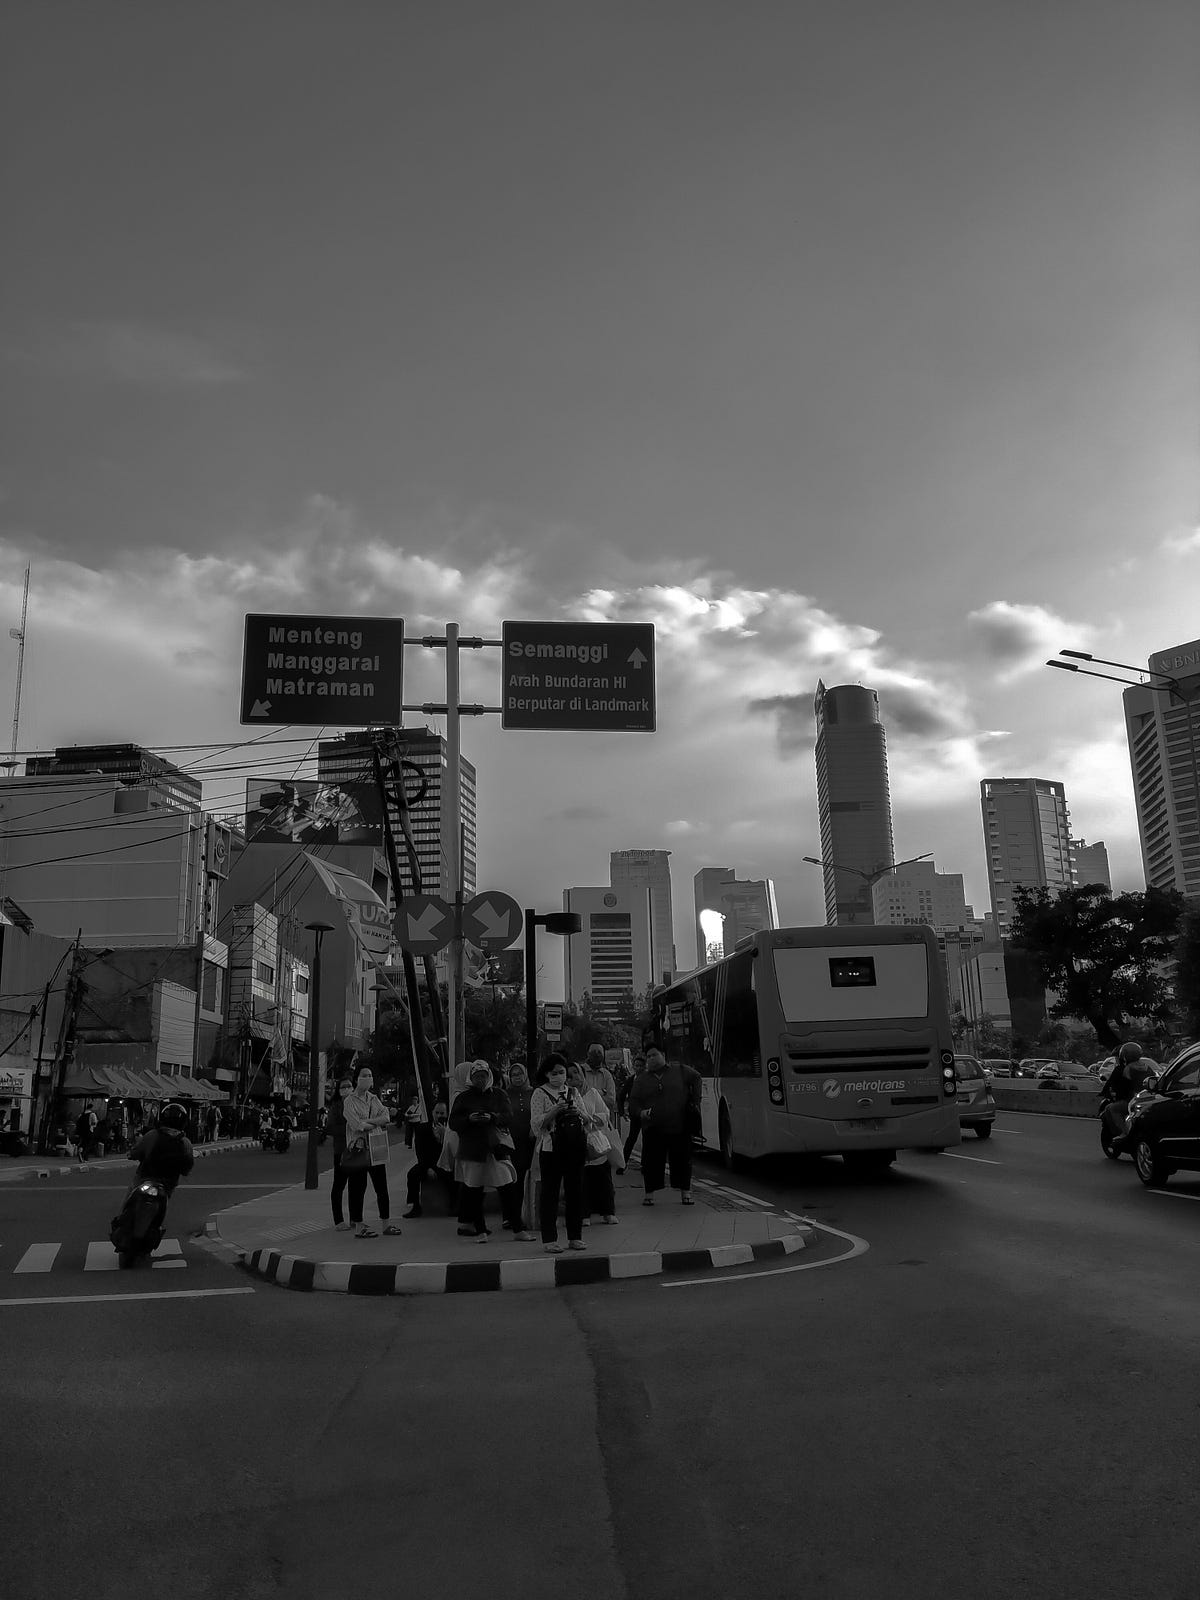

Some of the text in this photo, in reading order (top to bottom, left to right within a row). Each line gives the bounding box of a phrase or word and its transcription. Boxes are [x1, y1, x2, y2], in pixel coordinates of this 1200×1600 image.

[268, 626, 363, 650] Menteng
[509, 641, 608, 664] Semanggi
[267, 652, 380, 675] Manggarai
[266, 677, 375, 697] Matraman
[509, 674, 627, 689] Arah Bundaran HI
[508, 696, 649, 712] Berputar di Landmark
[789, 1083, 817, 1091] TJ796
[843, 1079, 905, 1093] metrotrans
